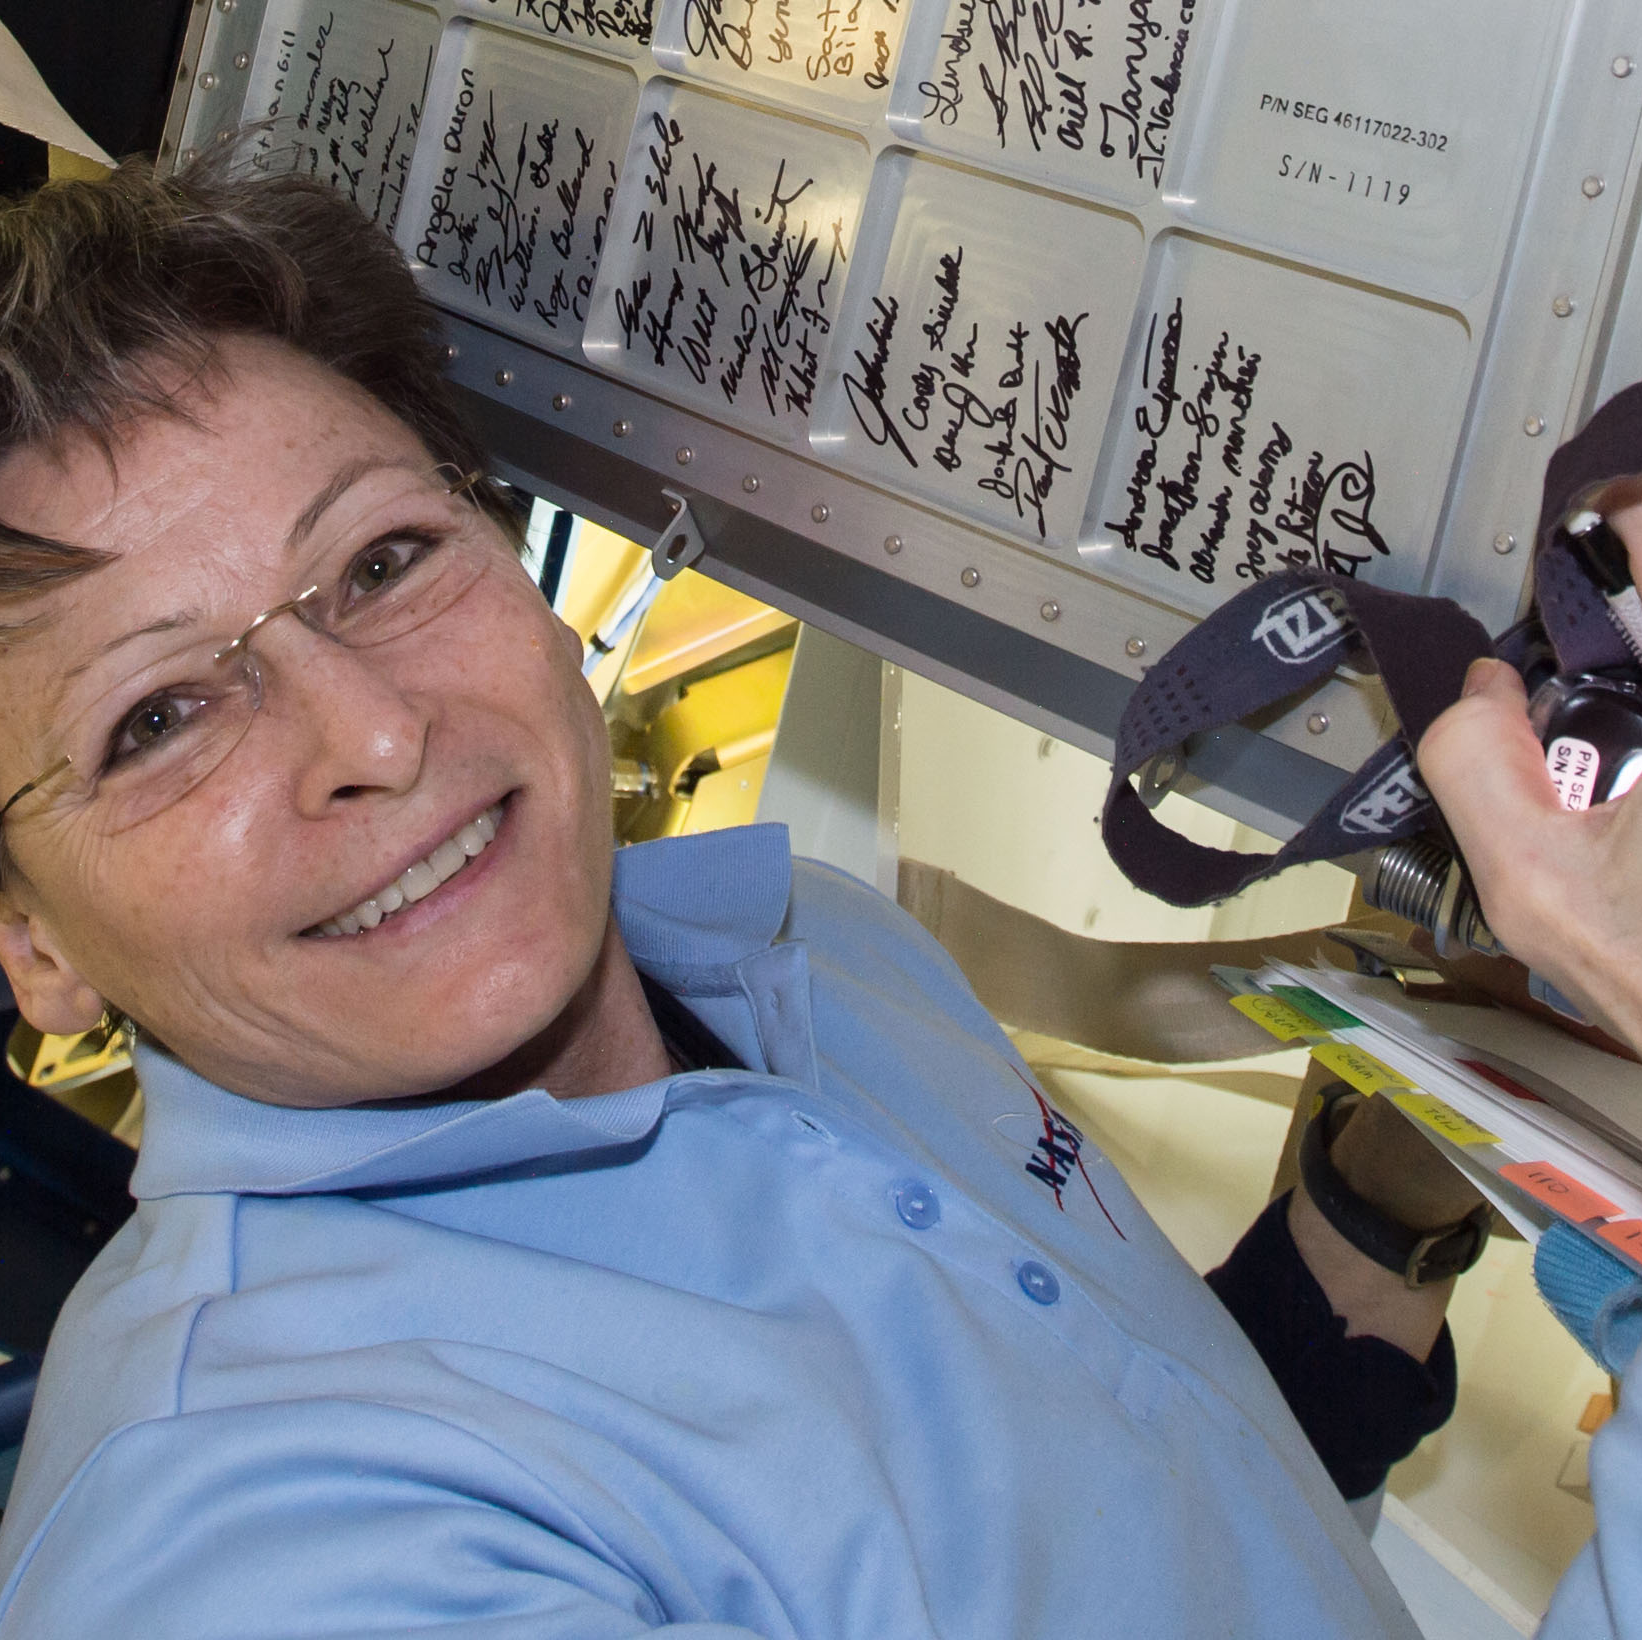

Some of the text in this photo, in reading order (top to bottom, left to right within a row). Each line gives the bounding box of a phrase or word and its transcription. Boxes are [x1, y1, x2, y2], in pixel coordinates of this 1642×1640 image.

[276, 30, 296, 73] Gill
[1260, 94, 1448, 152] P/N SEG 46117022-302
[415, 68, 475, 269] Angela Duron
[1251, 591, 1347, 655] TZL
[1554, 745, 1571, 773] S/N
[1574, 750, 1592, 778] P/N
[1345, 765, 1429, 833] PET
